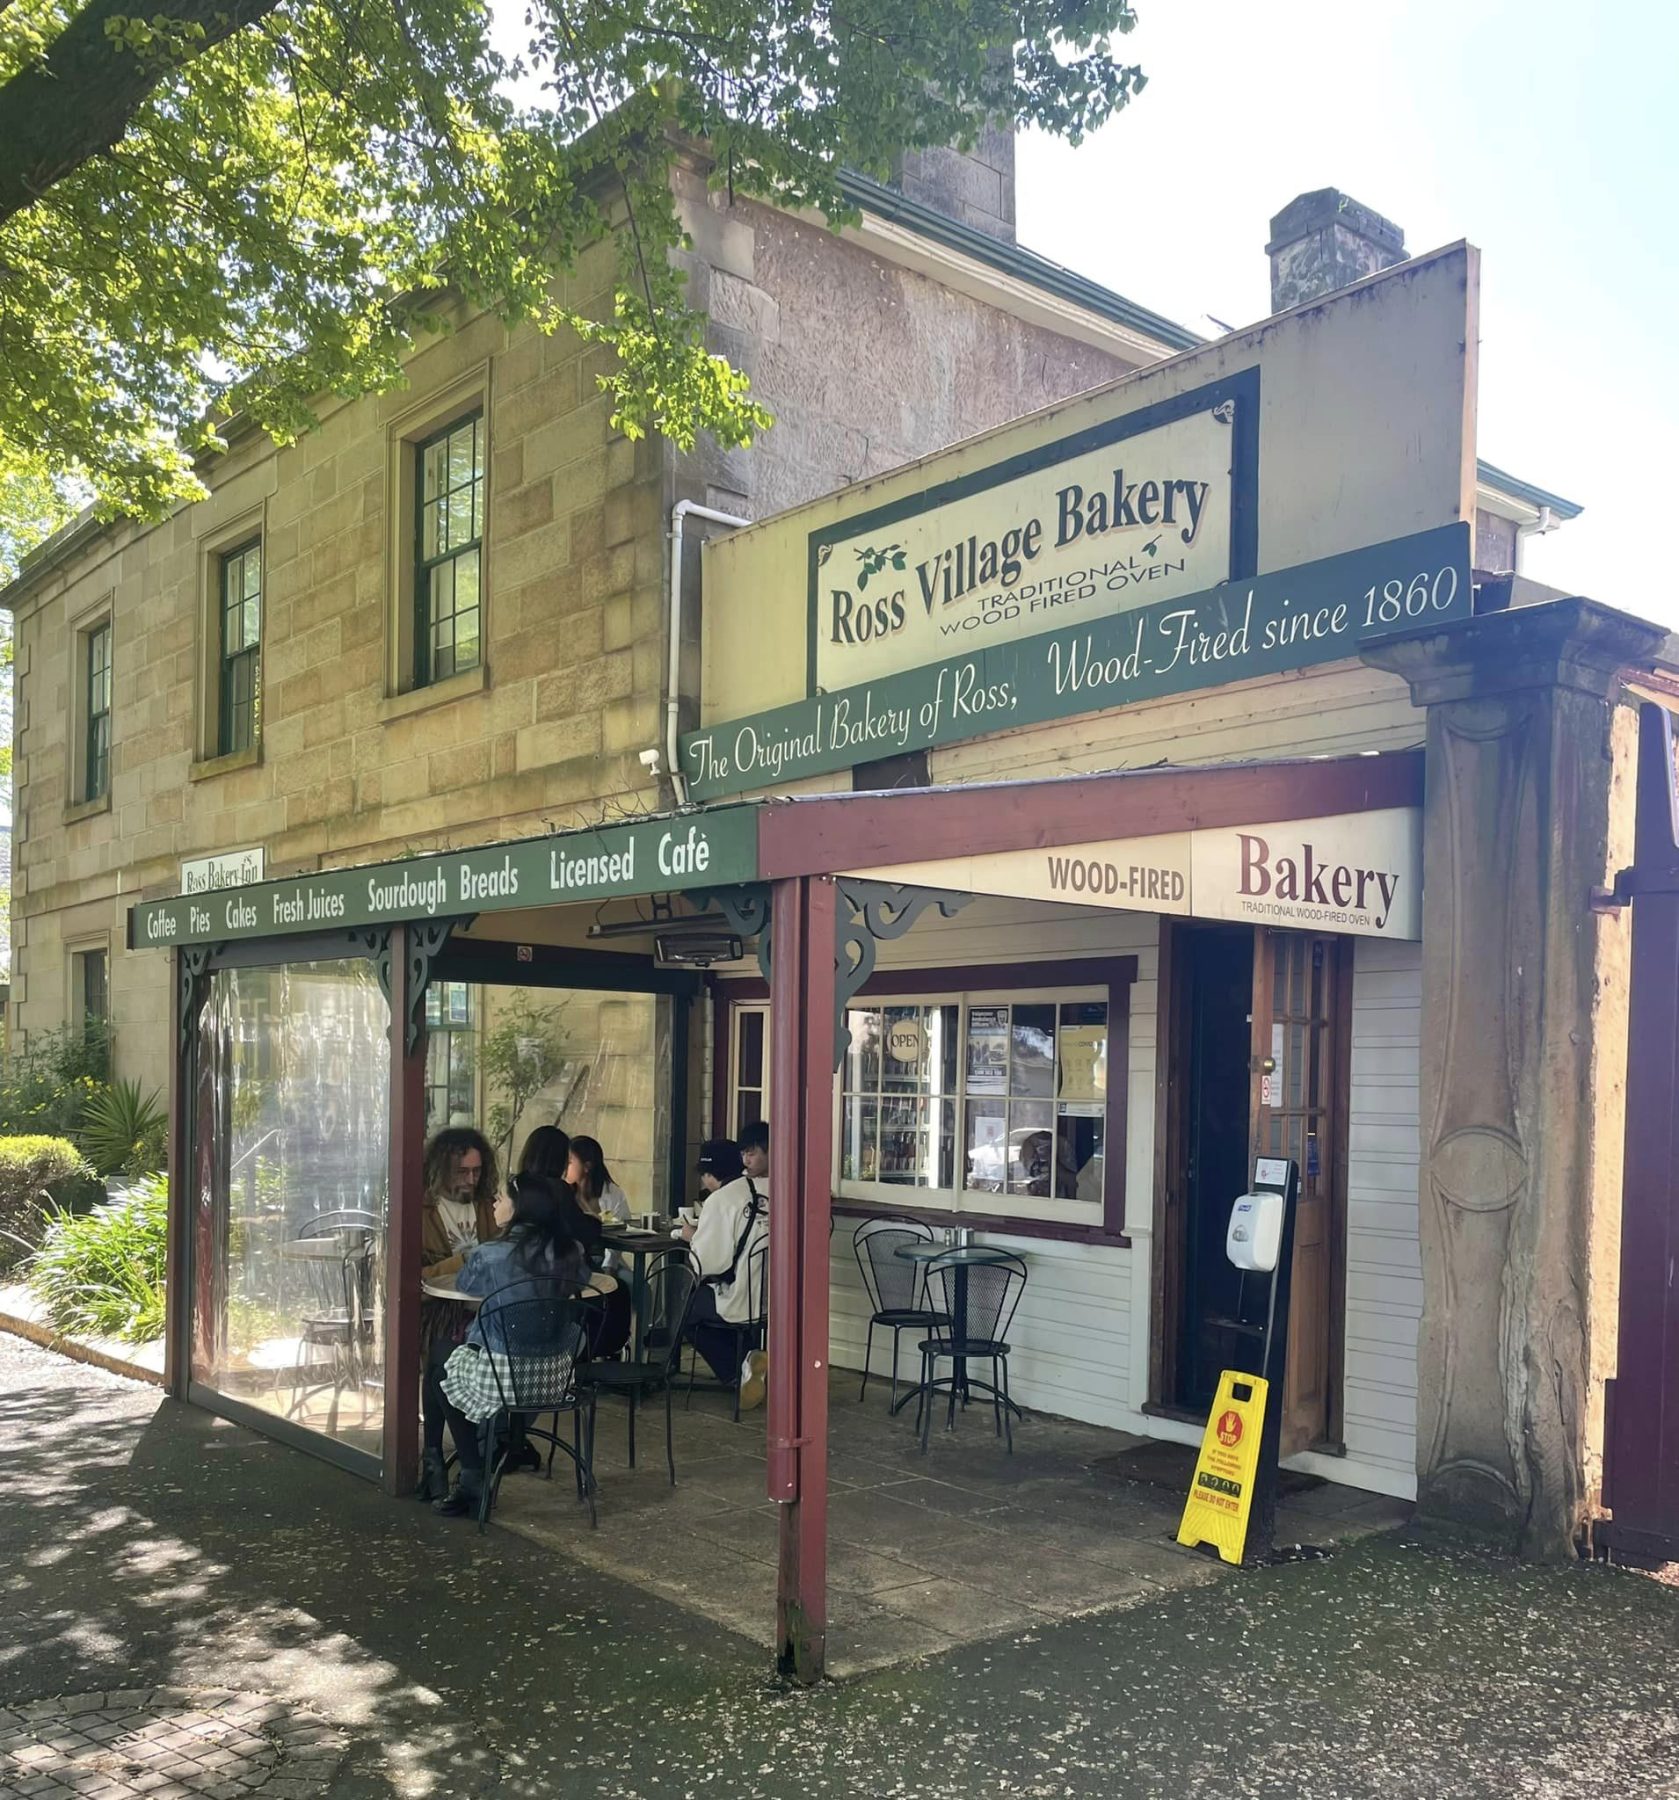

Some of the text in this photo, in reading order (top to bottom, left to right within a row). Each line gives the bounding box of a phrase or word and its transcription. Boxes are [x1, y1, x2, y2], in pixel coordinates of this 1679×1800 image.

[831, 468, 1209, 645] Ross Village Bakery
[977, 556, 1141, 611] TRADITIONAL
[940, 559, 1185, 636] WOOD FIRED OVEN
[689, 566, 1458, 786] The Original Bakery of Ross, Wood-Fired since 1860
[147, 908, 177, 939] Coffee
[190, 906, 211, 934] Pies
[225, 897, 257, 930] Cakes
[273, 894, 304, 924] Fresh
[307, 889, 345, 920] Juices
[367, 867, 447, 915] Sourdough
[460, 856, 519, 900] Breads
[550, 837, 634, 890] Licensed
[187, 861, 258, 893] Ross Bakery Inn
[1047, 833, 1400, 929] WOOD-FIRED Bakery
[1242, 901, 1370, 926] TRADITIONAL WOOD-FIRED OVEN
[892, 1034, 919, 1047] OPEN
[1220, 1432, 1237, 1444] STOP
[1194, 1489, 1209, 1502] PLEASE
[1209, 1494, 1216, 1504] DO
[1216, 1496, 1224, 1506] NOT
[1225, 1498, 1239, 1512] ENTER
